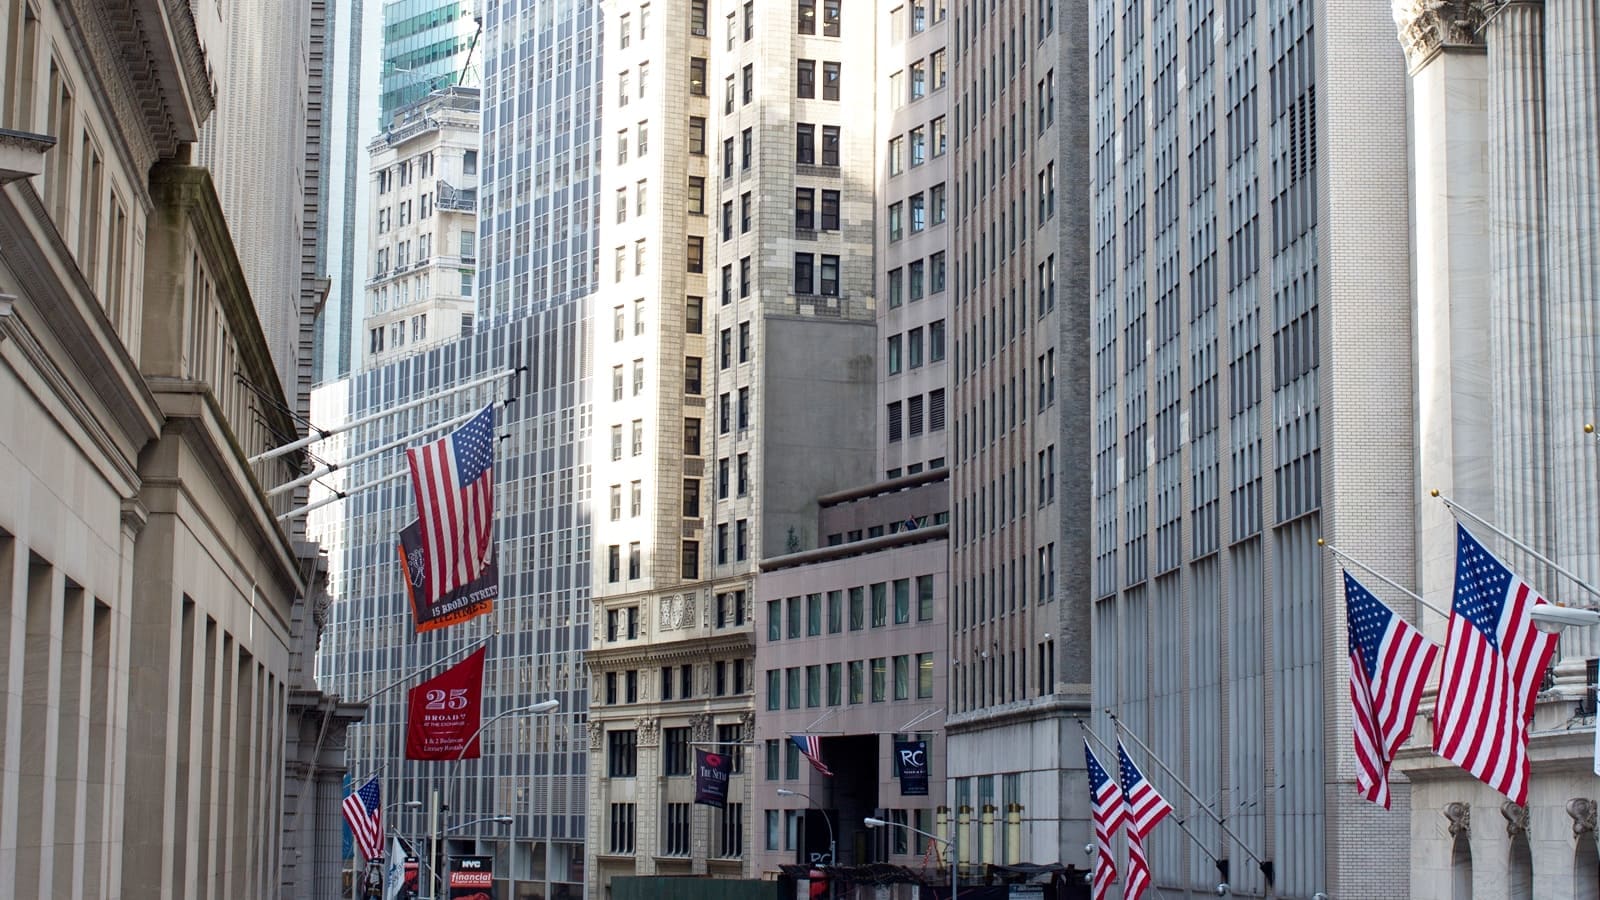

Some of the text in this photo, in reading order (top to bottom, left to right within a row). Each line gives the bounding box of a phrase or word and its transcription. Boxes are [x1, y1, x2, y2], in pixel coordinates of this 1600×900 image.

[432, 585, 499, 617] 15 BROAD STREET
[425, 688, 468, 710] 25
[900, 750, 924, 768] RC
[462, 860, 481, 868] NYC
[451, 872, 491, 882] financial
